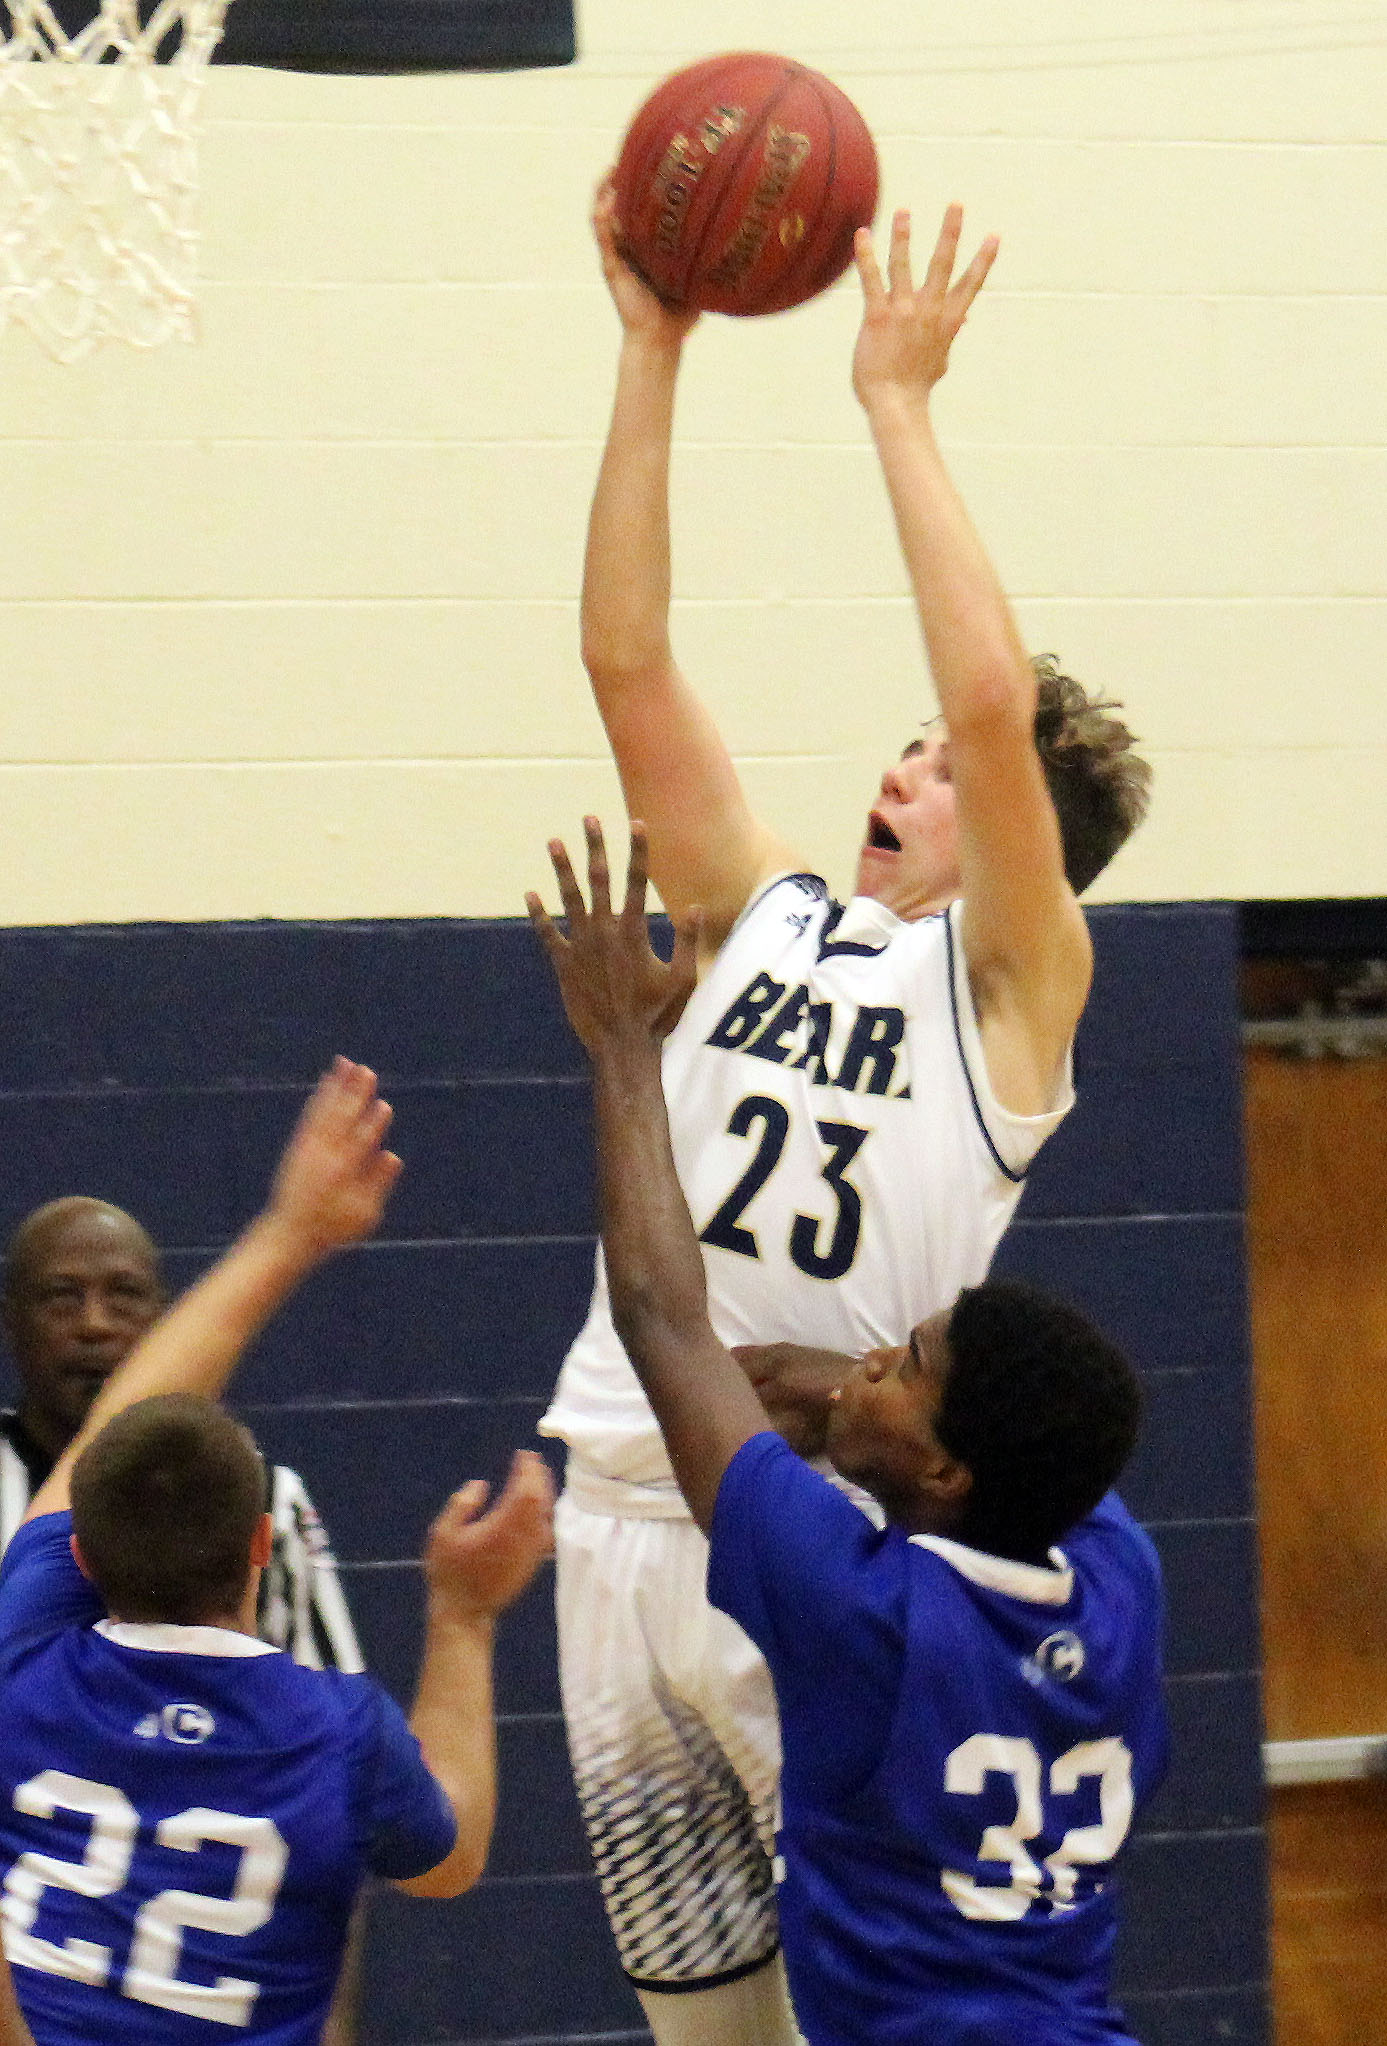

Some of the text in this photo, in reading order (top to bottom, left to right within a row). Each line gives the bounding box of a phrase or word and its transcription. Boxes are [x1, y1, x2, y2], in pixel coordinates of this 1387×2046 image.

[705, 971, 912, 1099] BEAR
[699, 1096, 870, 1280] 23
[0, 1769, 289, 2027] 22
[940, 1734, 1134, 1921] 32
